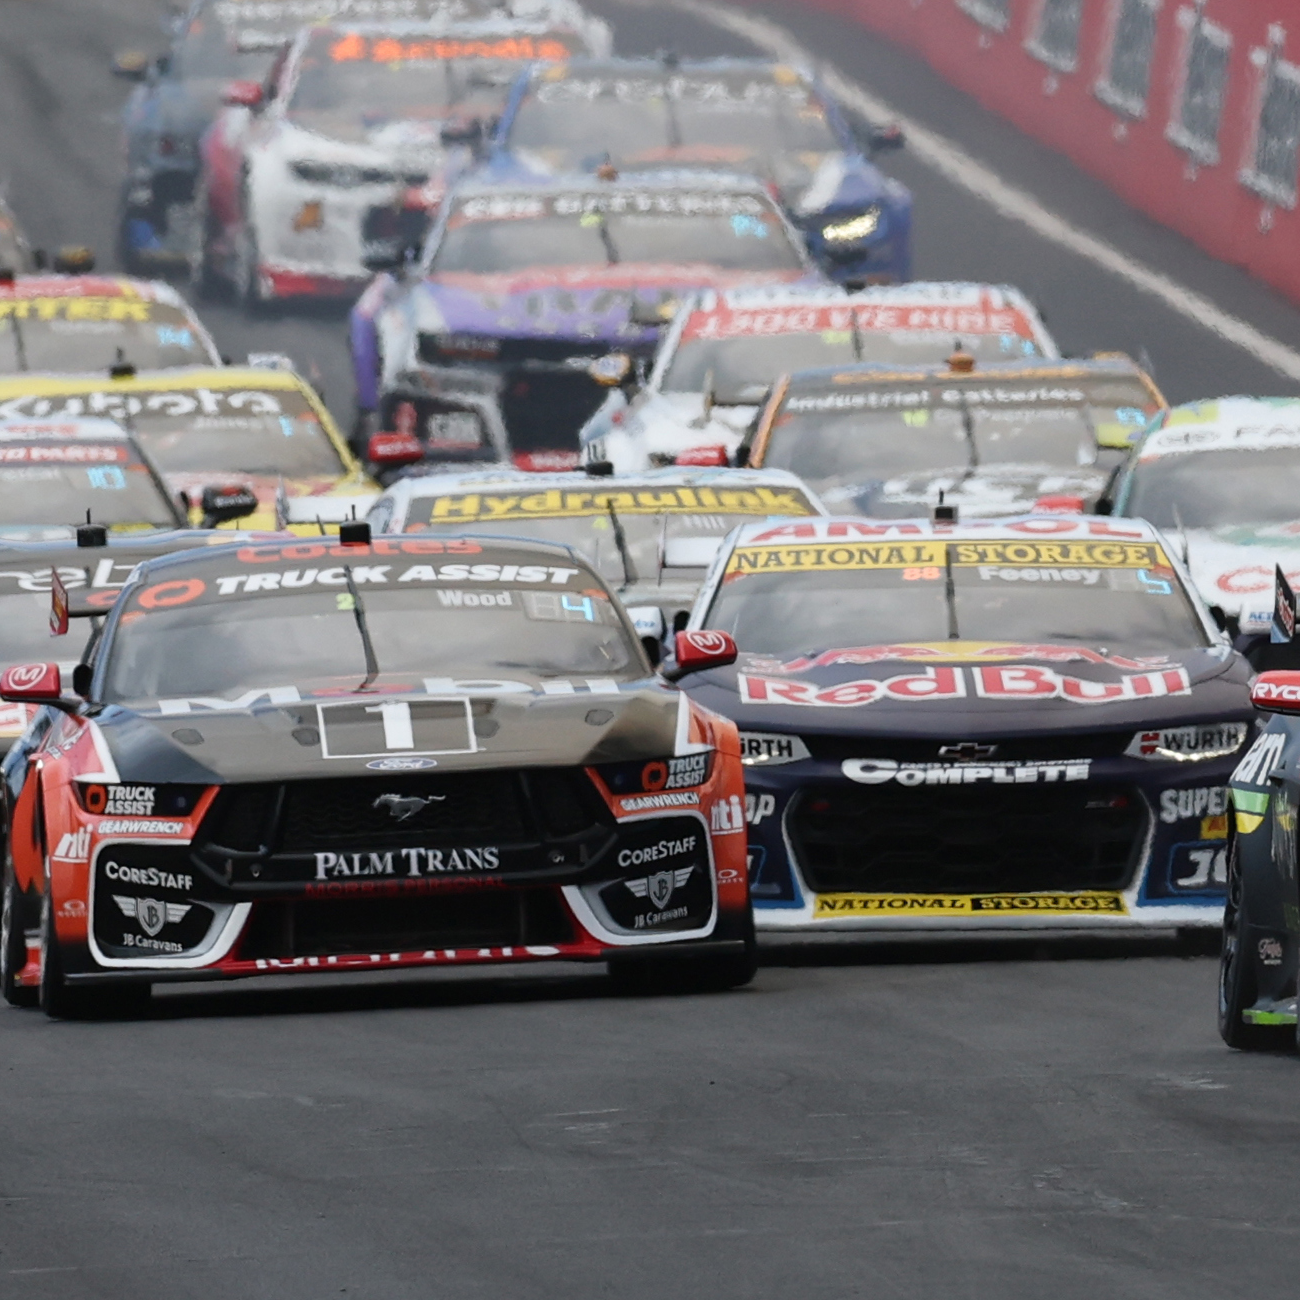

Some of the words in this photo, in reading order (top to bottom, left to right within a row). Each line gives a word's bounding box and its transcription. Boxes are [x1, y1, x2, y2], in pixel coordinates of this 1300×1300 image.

[432, 487, 801, 519] Hydraulink
[749, 519, 1144, 543] AMOL
[733, 545, 936, 571] NATIONAL
[954, 542, 1151, 568] STORAGE
[216, 567, 393, 595] TRUCK
[397, 564, 579, 584] ASSIST
[977, 567, 1100, 585] Feeney
[437, 589, 512, 608] Wood
[739, 666, 966, 707] Red
[976, 666, 1191, 701] Bull
[1165, 726, 1239, 750] WÜRTH
[668, 757, 705, 774] TRUCK
[842, 758, 1091, 786] COMPLETE
[665, 771, 704, 789] ASSIST
[107, 786, 155, 801] TRUCK
[620, 792, 699, 811] GEARWRENCH
[104, 801, 154, 815] ASSIST
[98, 821, 183, 834] GEARWRENCH
[818, 898, 965, 911] NATIONAL
[123, 933, 134, 947] JB
[136, 935, 183, 952] Caravans
